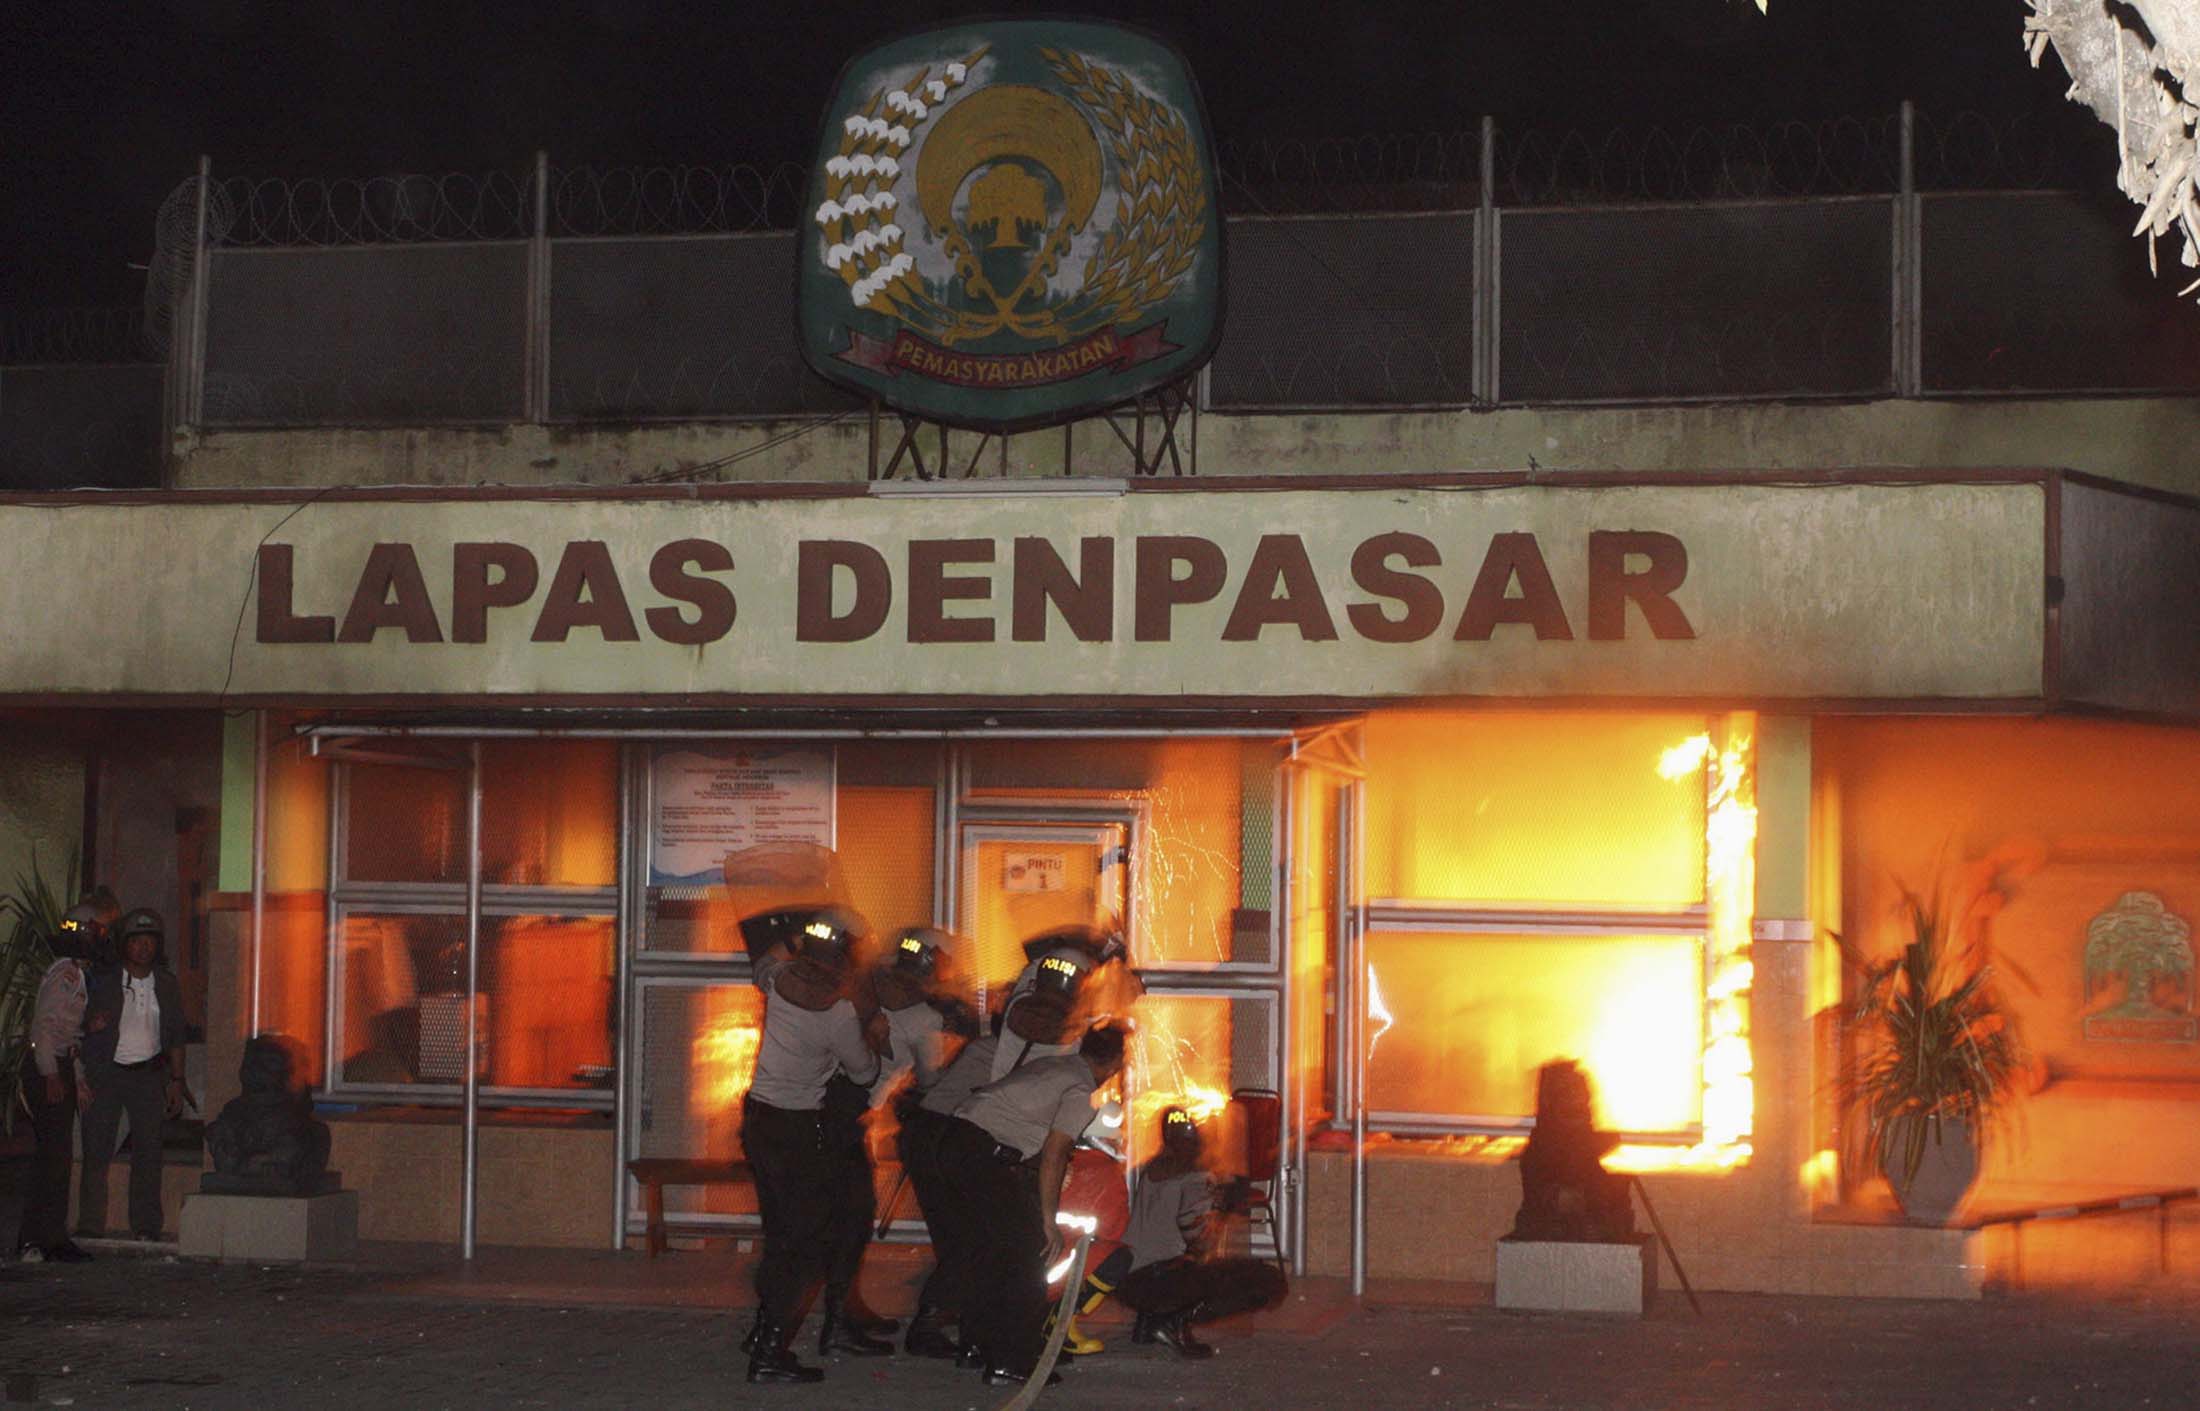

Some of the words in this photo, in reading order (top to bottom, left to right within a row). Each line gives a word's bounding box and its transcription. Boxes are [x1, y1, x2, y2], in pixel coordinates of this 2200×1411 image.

[899, 335, 1114, 381] PEMASYARAKATAN
[256, 538, 737, 645] LAPAS
[797, 530, 1695, 644] DENPASAR
[1028, 858, 1062, 870] PINTU
